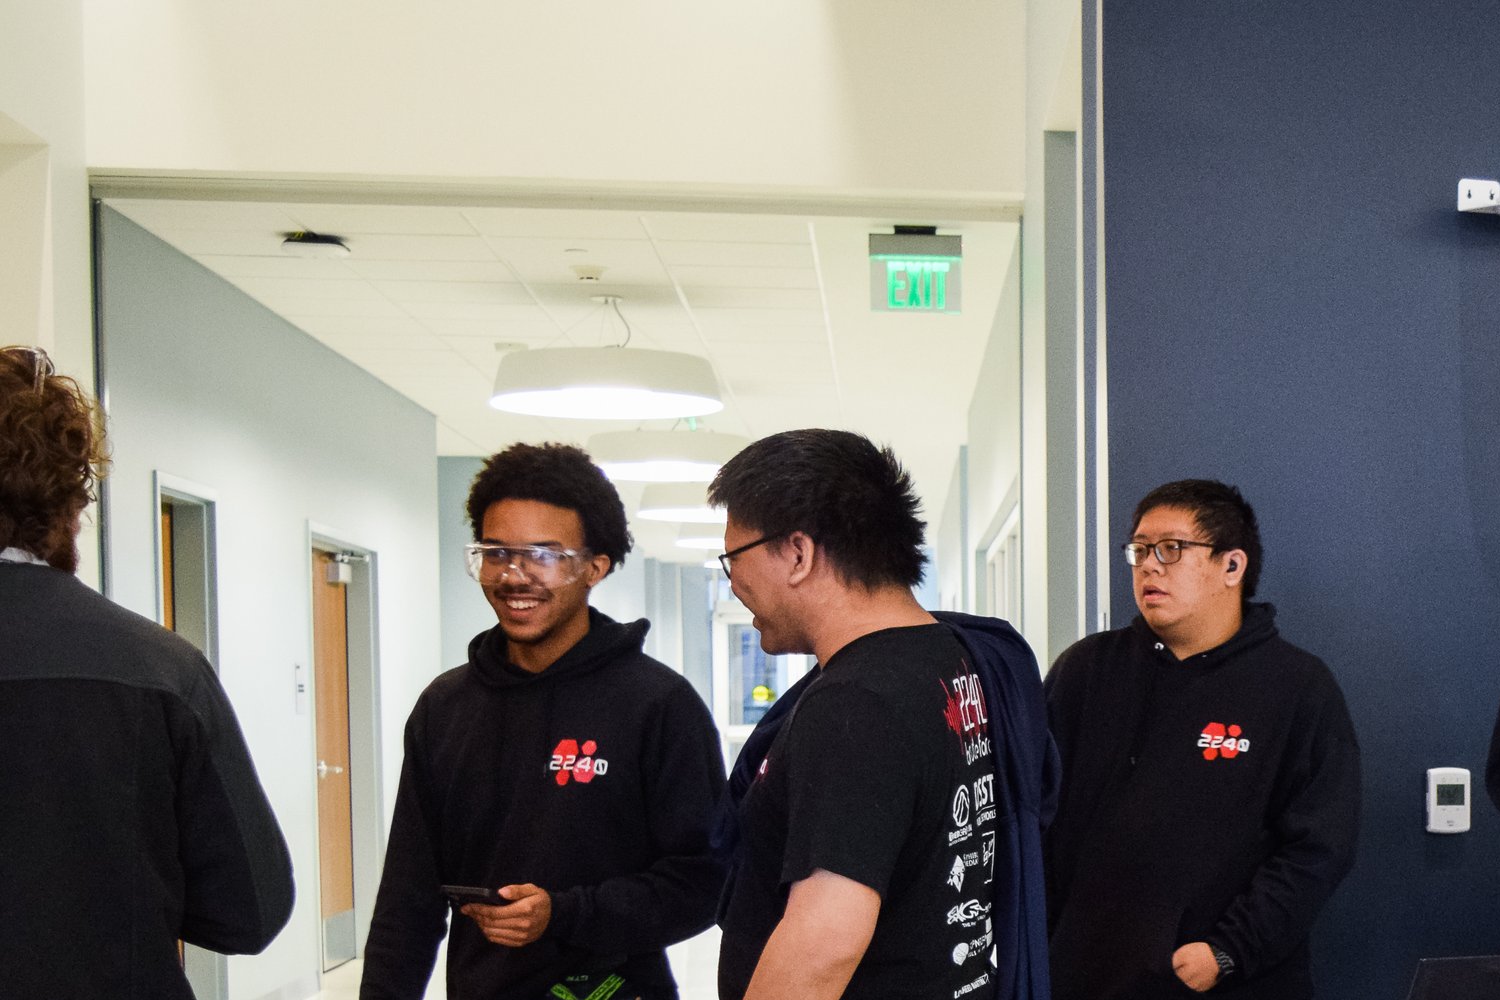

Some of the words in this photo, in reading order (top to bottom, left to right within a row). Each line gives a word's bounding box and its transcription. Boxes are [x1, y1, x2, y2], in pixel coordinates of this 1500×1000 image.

[887, 260, 950, 309] EXIT
[1197, 733, 1250, 753] 2240
[549, 755, 609, 776] 2240
